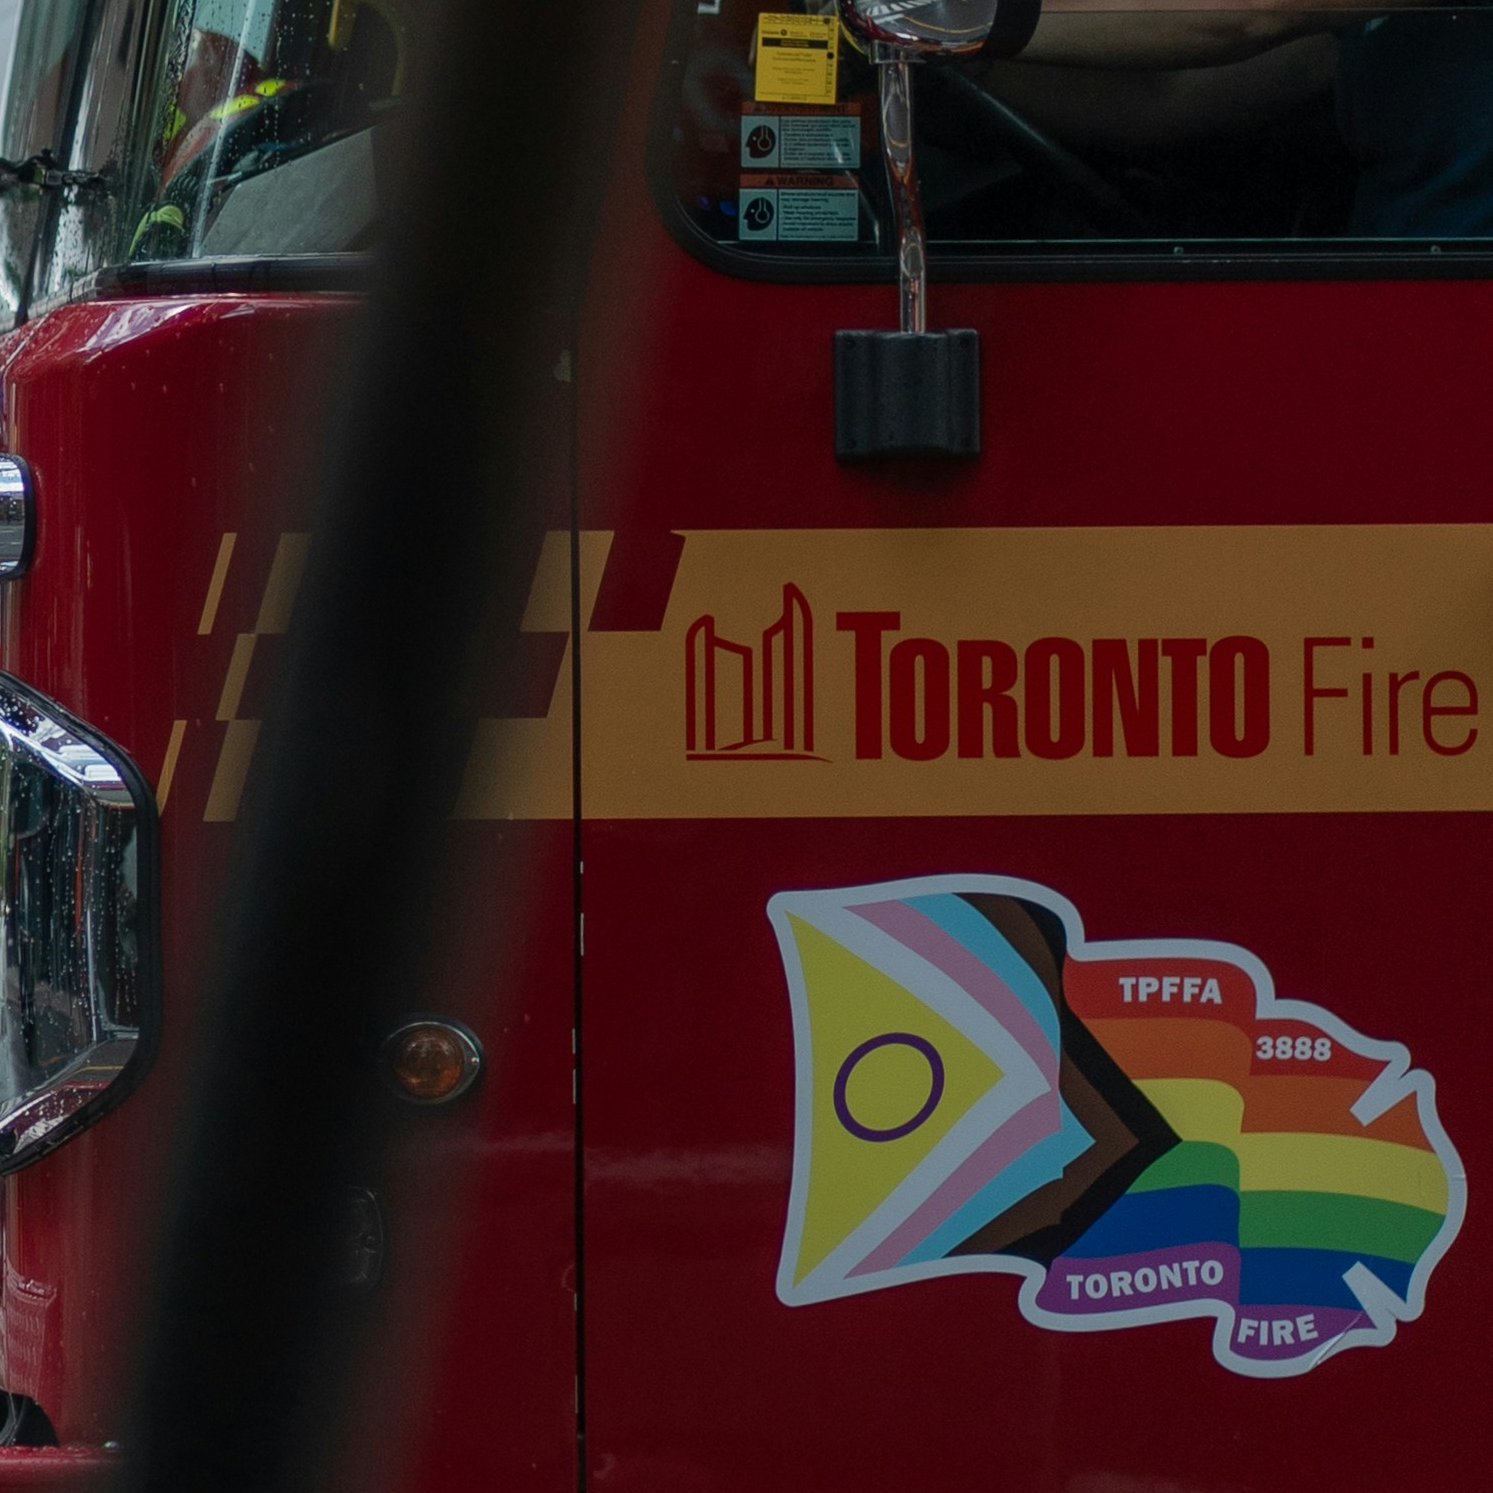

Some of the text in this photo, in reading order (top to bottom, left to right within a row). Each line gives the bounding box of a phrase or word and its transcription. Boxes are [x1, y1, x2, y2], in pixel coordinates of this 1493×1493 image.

[776, 176, 834, 186] WARNING
[835, 611, 1479, 761] TORONTO Fire
[1119, 975, 1223, 1005] TPFFA
[1255, 1034, 1332, 1063] 3888
[1066, 1259, 1225, 1301] TORONTO
[1236, 1314, 1320, 1347] FIRE
